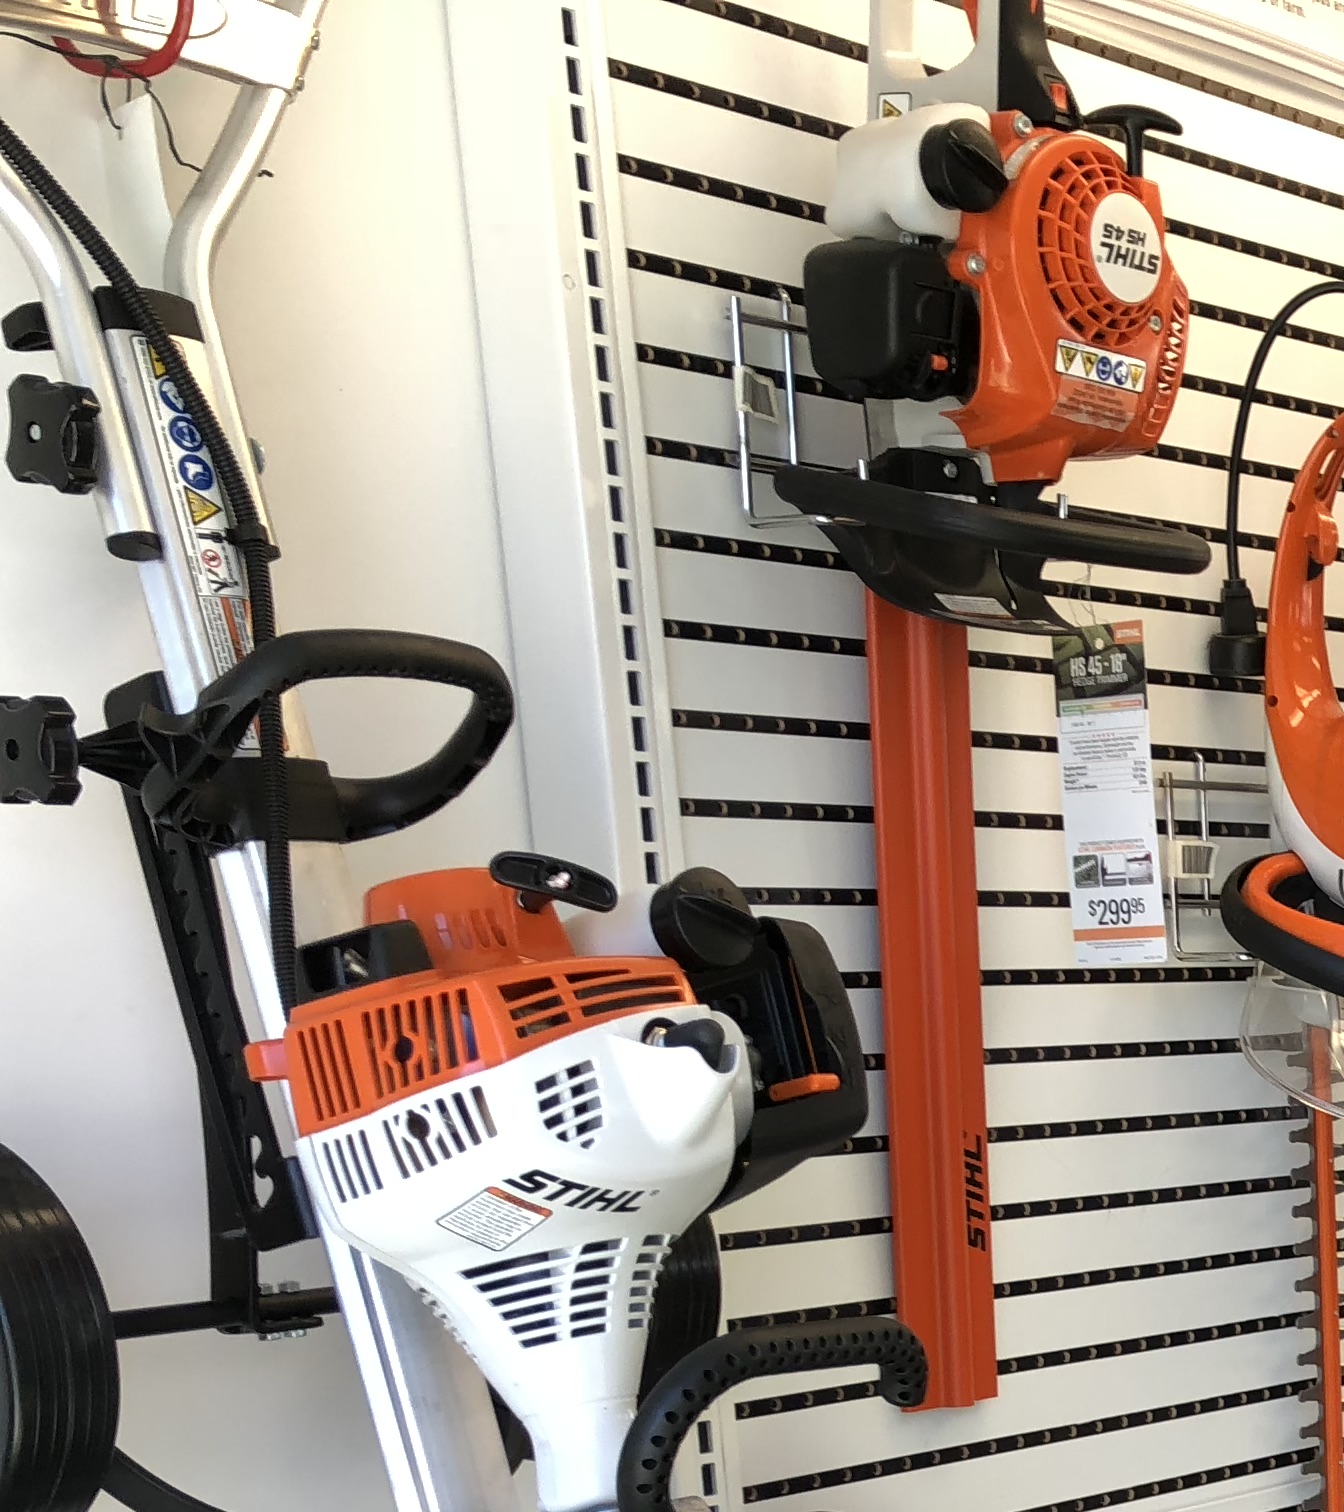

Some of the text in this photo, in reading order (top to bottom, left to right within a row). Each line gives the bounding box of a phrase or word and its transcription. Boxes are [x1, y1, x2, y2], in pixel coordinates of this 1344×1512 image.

[1102, 222, 1147, 247] HS 45
[1100, 241, 1161, 275] STIHL
[1069, 656, 1087, 678] HS
[1087, 655, 1103, 676] 45
[502, 1169, 650, 1212] STIHL
[963, 1133, 986, 1252] STIHL
